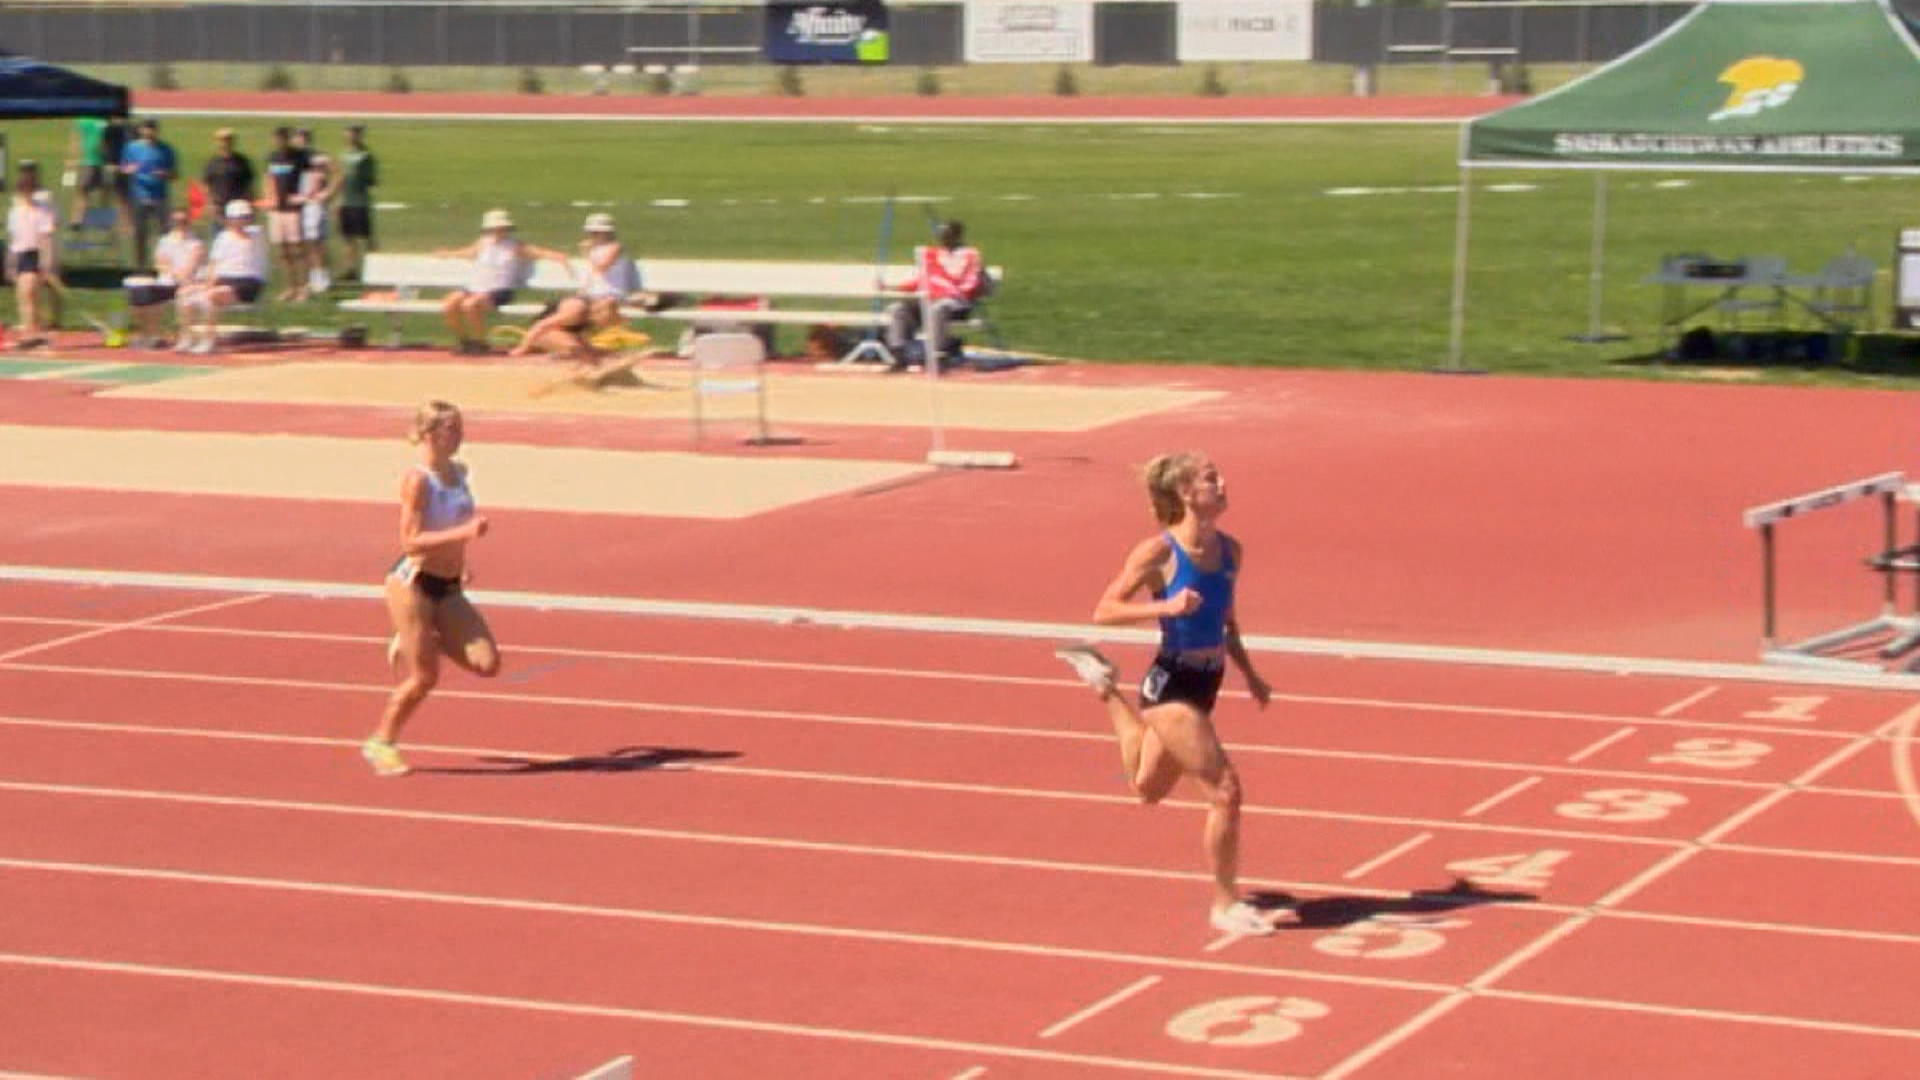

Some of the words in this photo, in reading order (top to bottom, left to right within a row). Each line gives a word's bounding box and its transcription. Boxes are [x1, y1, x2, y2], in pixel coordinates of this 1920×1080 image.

[1745, 696, 1831, 722] 1
[1649, 737, 1773, 768] 2
[1555, 788, 1689, 822] 3
[1444, 849, 1572, 887] 4
[1312, 913, 1473, 958] 5
[1165, 996, 1329, 1046] 6
